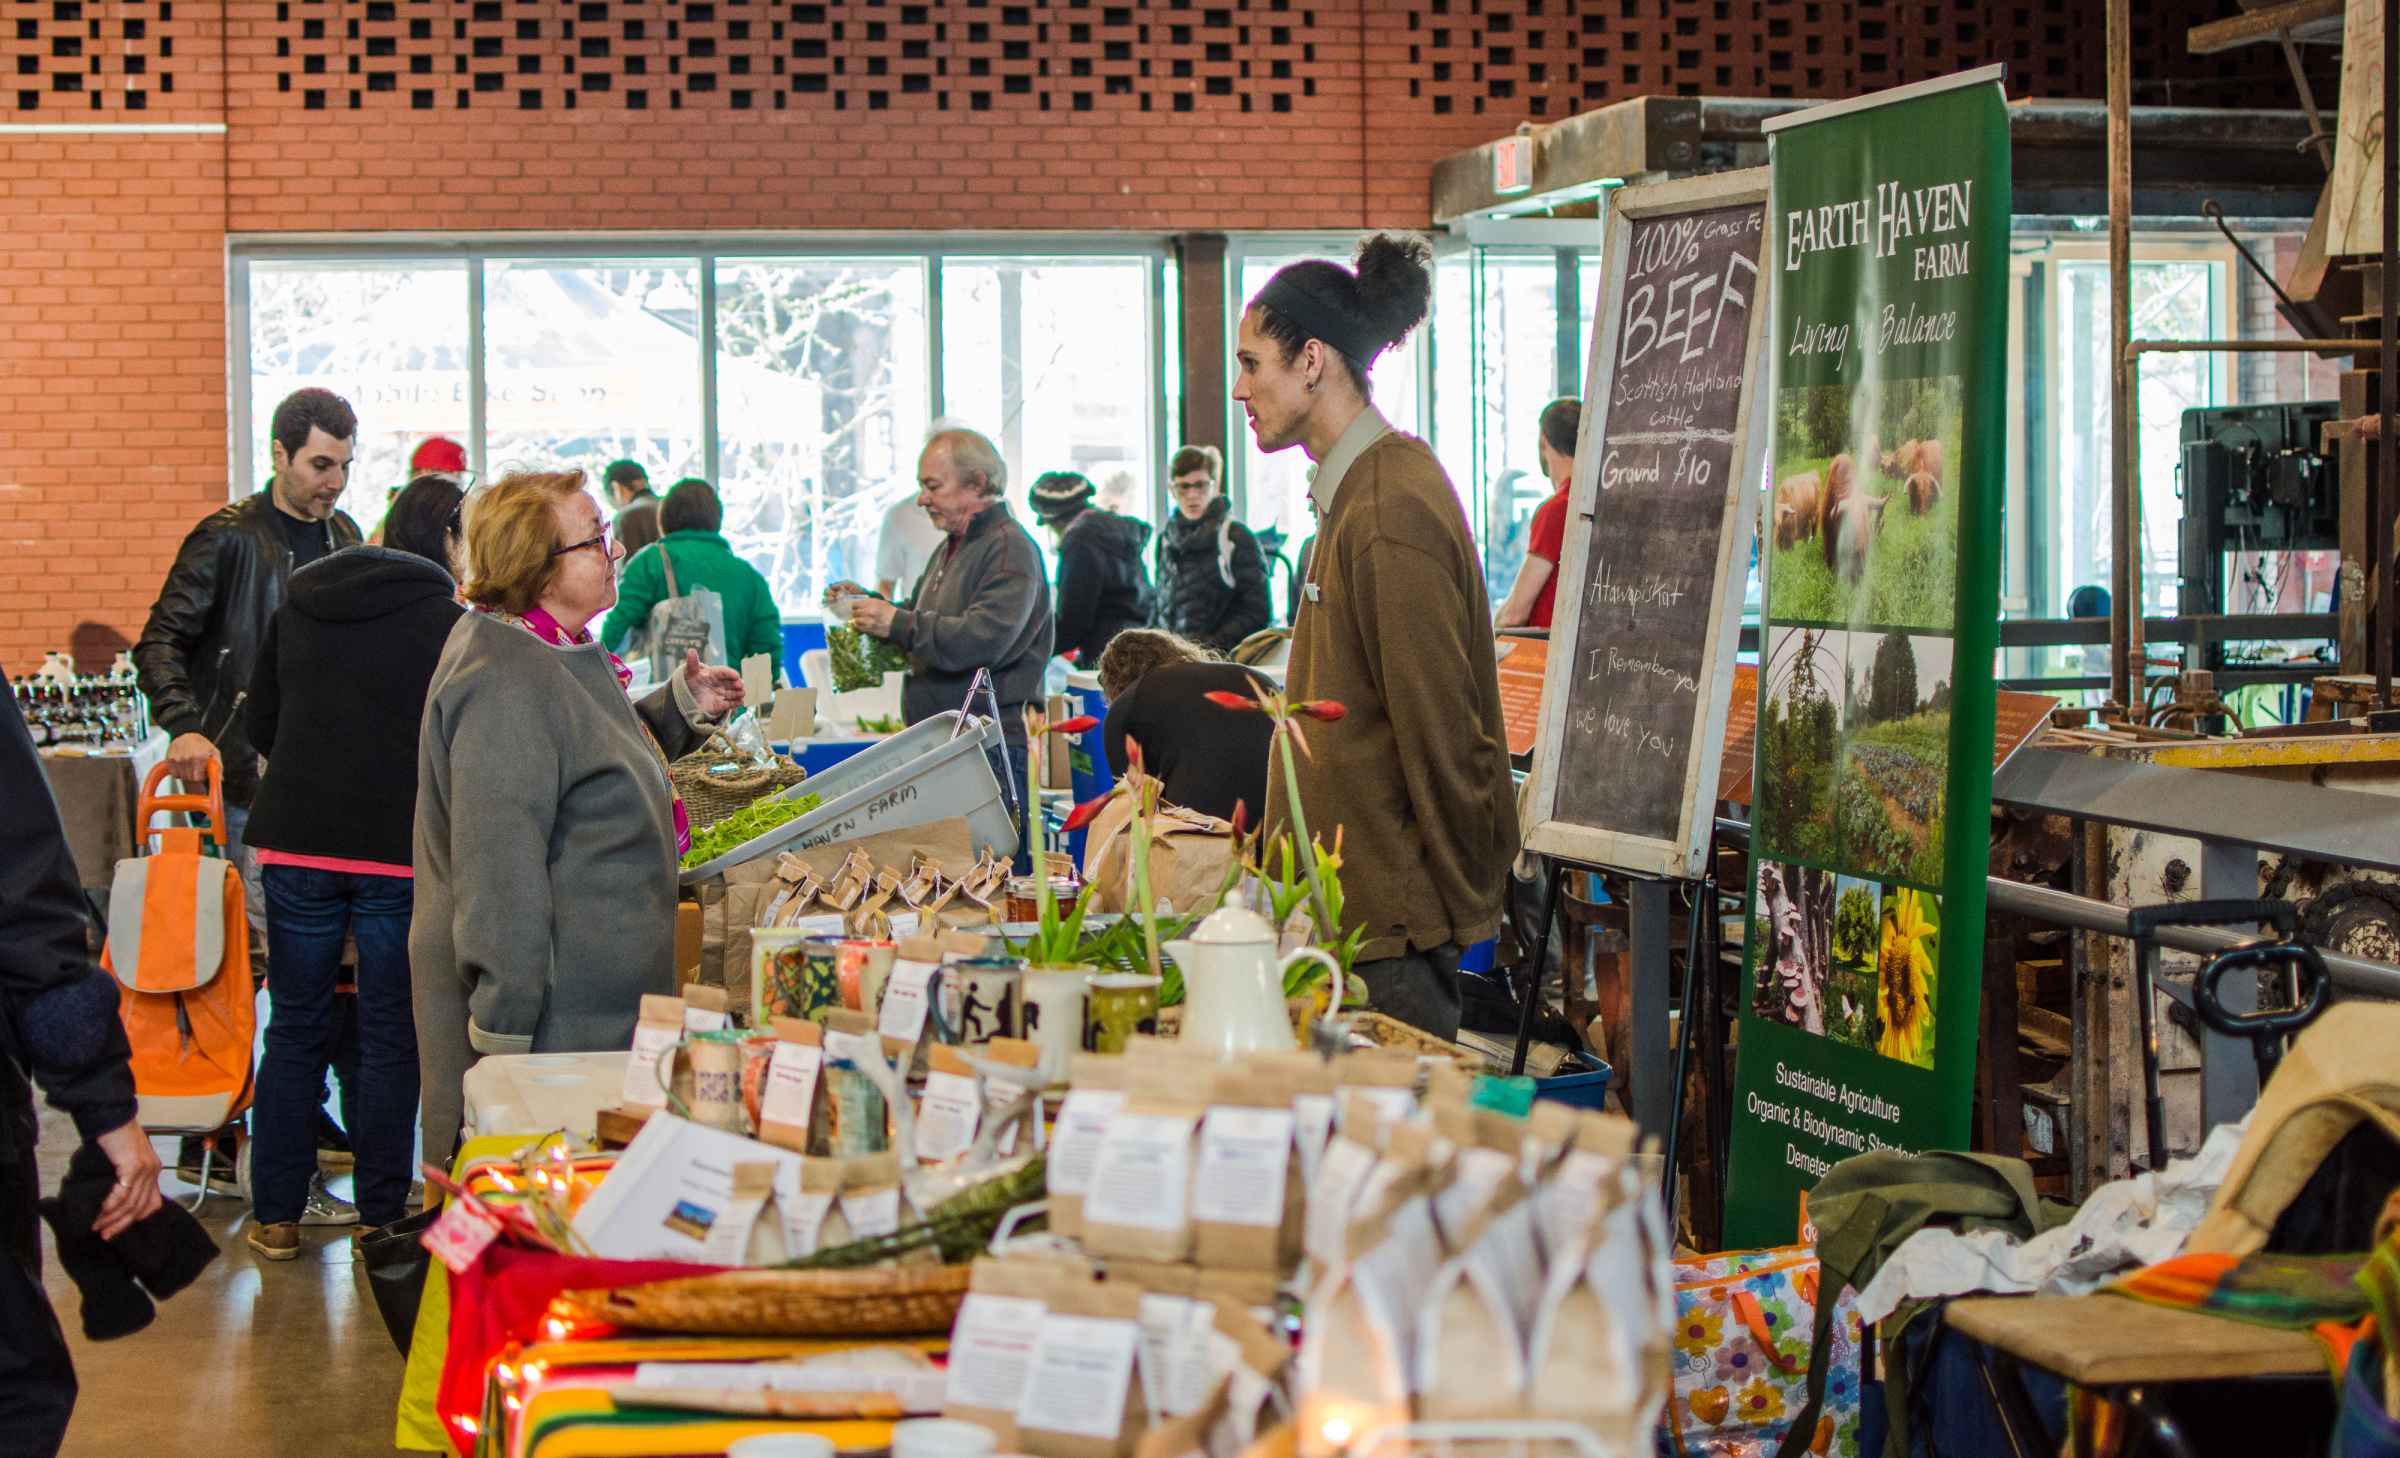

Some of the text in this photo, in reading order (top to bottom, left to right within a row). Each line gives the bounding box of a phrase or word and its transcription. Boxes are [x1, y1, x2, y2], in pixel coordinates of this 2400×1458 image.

[1628, 217, 1703, 280] 100%
[1785, 180, 1972, 271] EARTH HAVEN
[1913, 241, 1970, 281] FARM
[1621, 251, 1760, 368] BEEF
[1788, 315, 1849, 371] Living
[1877, 302, 1956, 355] Balance
[1615, 360, 1743, 411] Scottish Highland
[1650, 405, 1696, 430] cattle
[1601, 441, 1711, 489] Ground $10
[1588, 648, 1601, 680] I
[1603, 697, 1632, 738] love
[867, 784, 918, 820] FARM
[1776, 1062, 1901, 1124] Sustainable Agriculture
[1747, 1091, 1791, 1123] Organic
[1792, 1106, 1801, 1129] &
[1803, 1109, 1865, 1152] Biodynamic
[1786, 1142, 1831, 1178] Demeter
